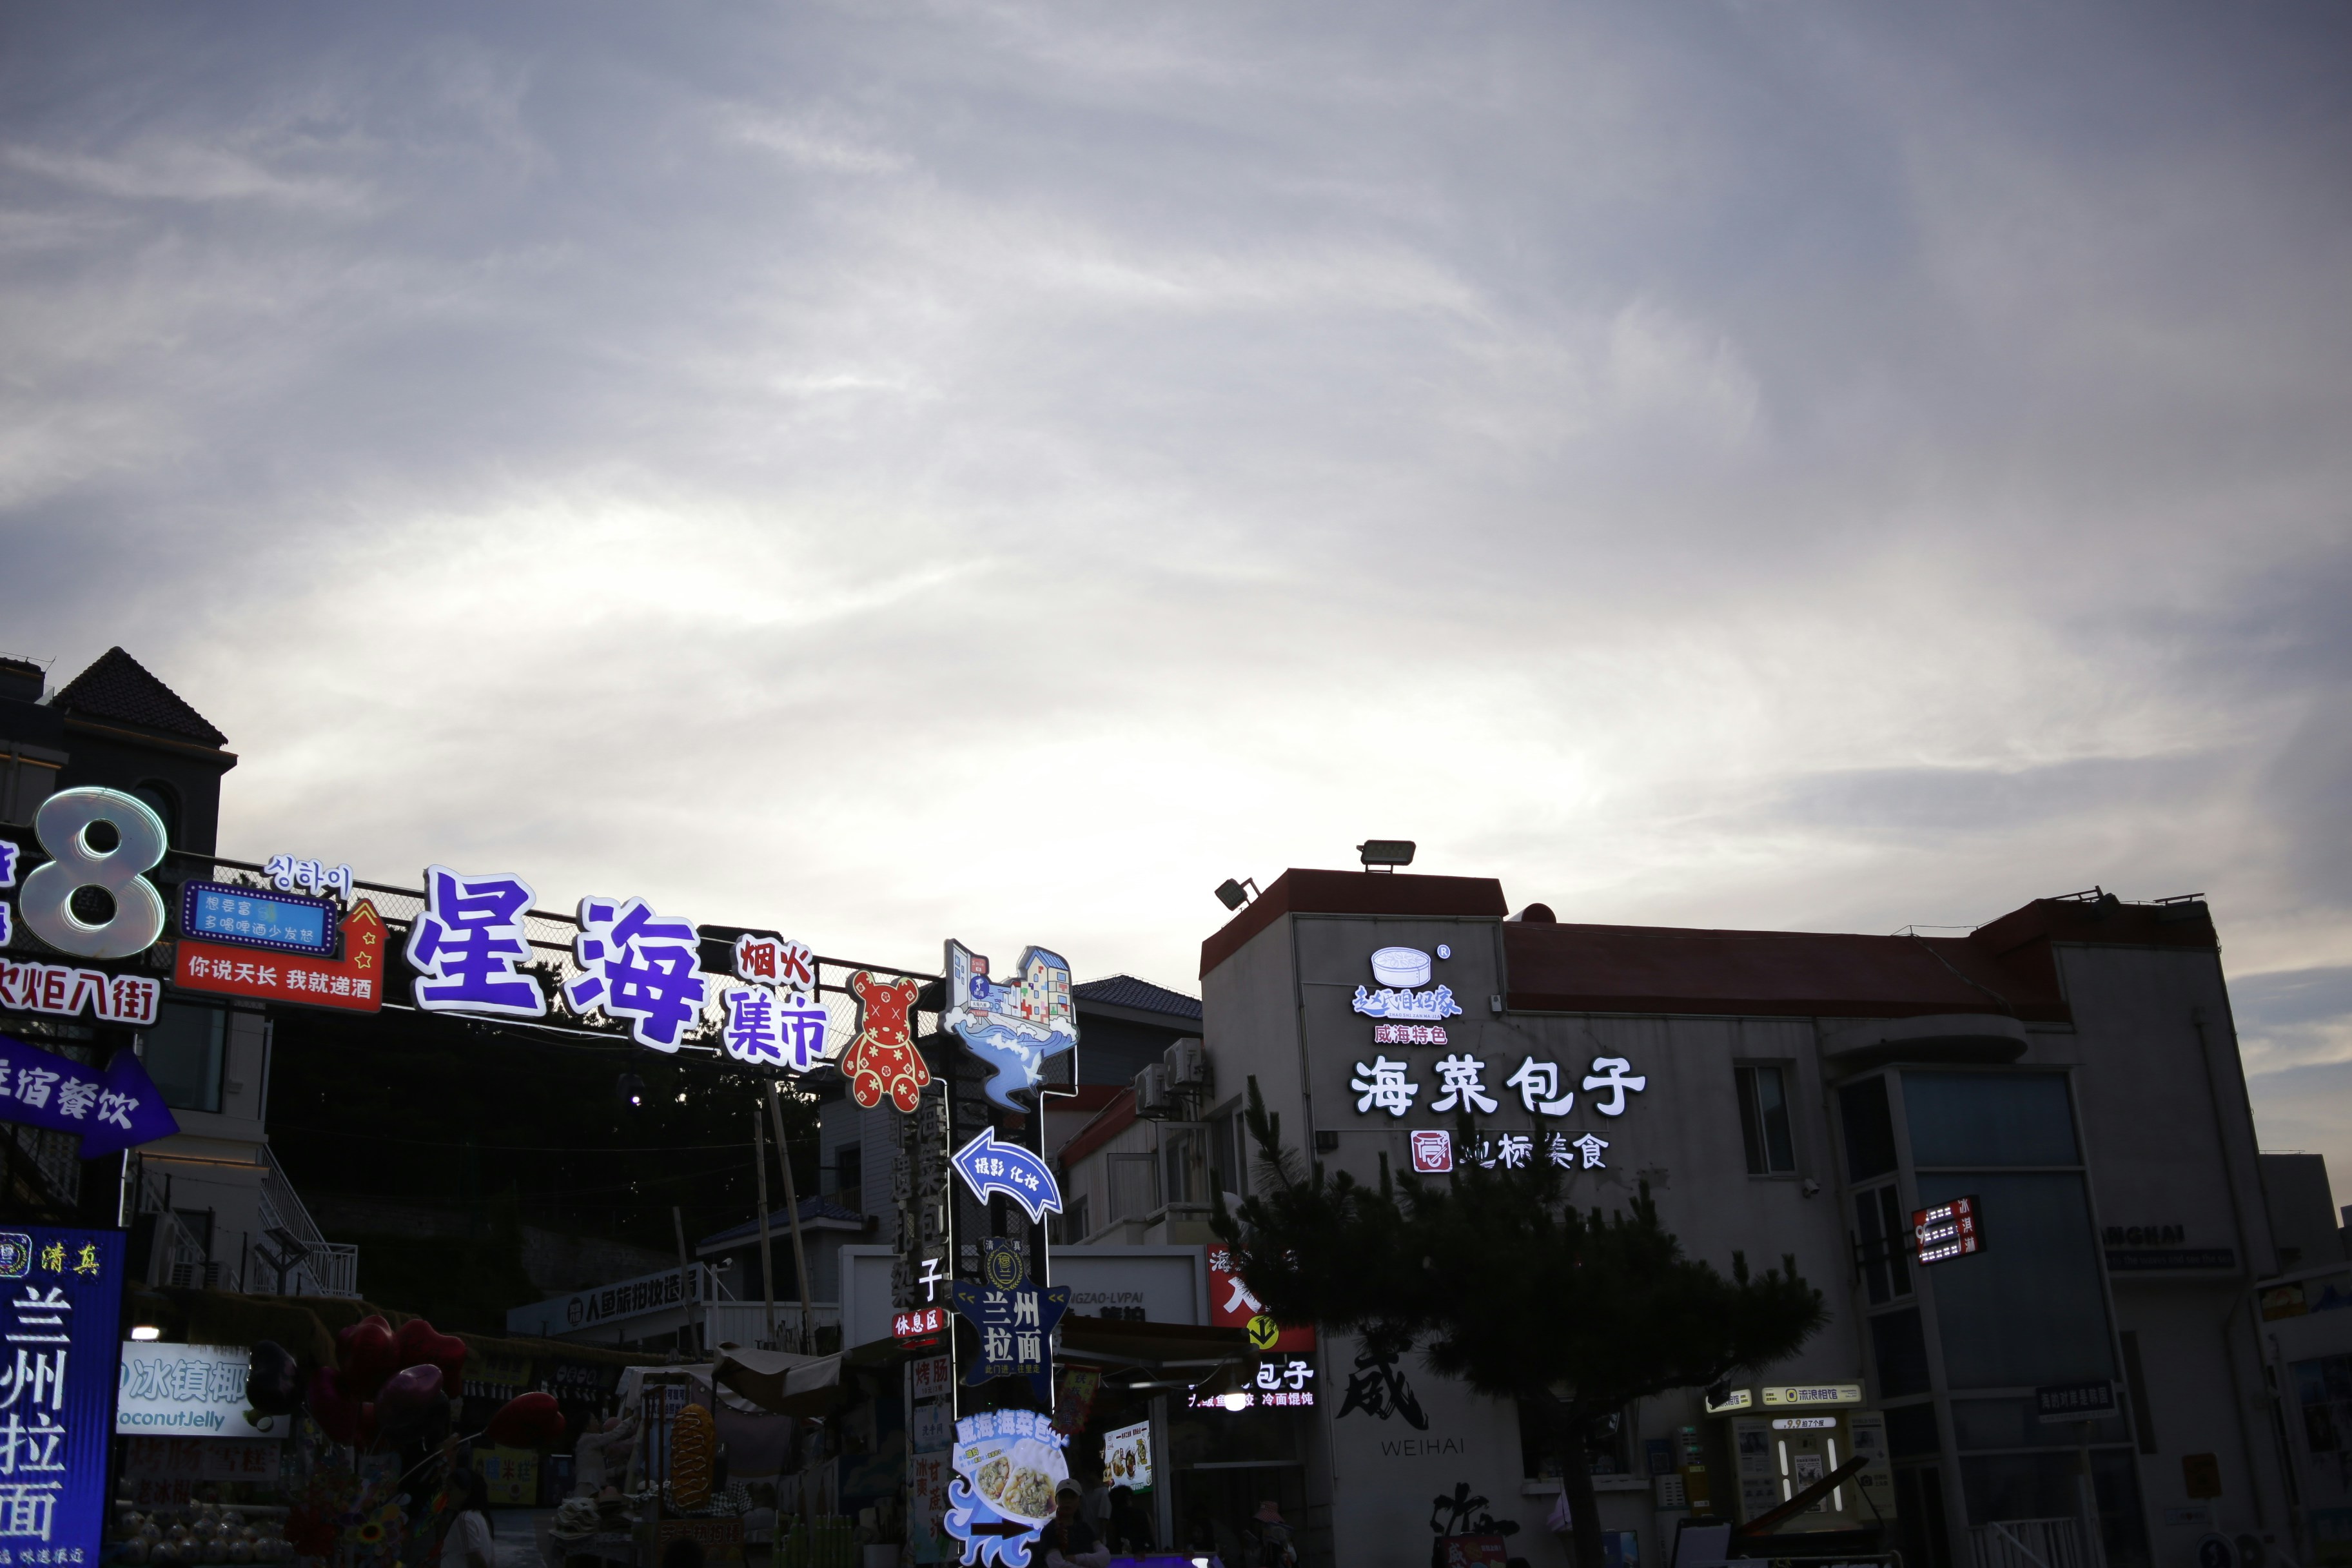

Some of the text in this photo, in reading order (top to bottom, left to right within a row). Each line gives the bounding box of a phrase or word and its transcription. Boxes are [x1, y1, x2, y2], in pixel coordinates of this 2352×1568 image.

[19, 787, 167, 959] 8
[266, 856, 351, 899] 싱하이
[205, 895, 251, 916] 想要富
[203, 914, 314, 942] 多喝啤酒少发怒
[415, 872, 704, 1044] 星海
[740, 941, 811, 984] 烟火
[0, 962, 152, 1020] 火炬八街
[188, 956, 372, 998] 你说天长 我就递酒
[1354, 986, 1461, 1015] 赵氏咱妈家
[728, 991, 827, 1067] 集市
[1375, 1025, 1447, 1044] 威海特色
[1351, 1055, 1646, 1117] 海菜包子
[975, 1157, 1039, 1191] 摄影 化妆
[1958, 1199, 1975, 1252] 冰淇淋
[2102, 1224, 2185, 1244] NGHAI
[41, 1241, 100, 1275] 清真
[896, 1309, 938, 1336] 休息区
[983, 1291, 1040, 1327] 兰州
[983, 1327, 1041, 1364] 拉面
[916, 1358, 948, 1386] 烤肠
[1262, 1392, 1313, 1406] 冷面馄饨
[1799, 1389, 1838, 1400] 流浪相馆
[0, 1286, 72, 1542] 兰州拉面
[118, 1411, 224, 1431] oconutJelly
[922, 1423, 943, 1436] 洗手间
[1381, 1438, 1464, 1456] WEIHAI
